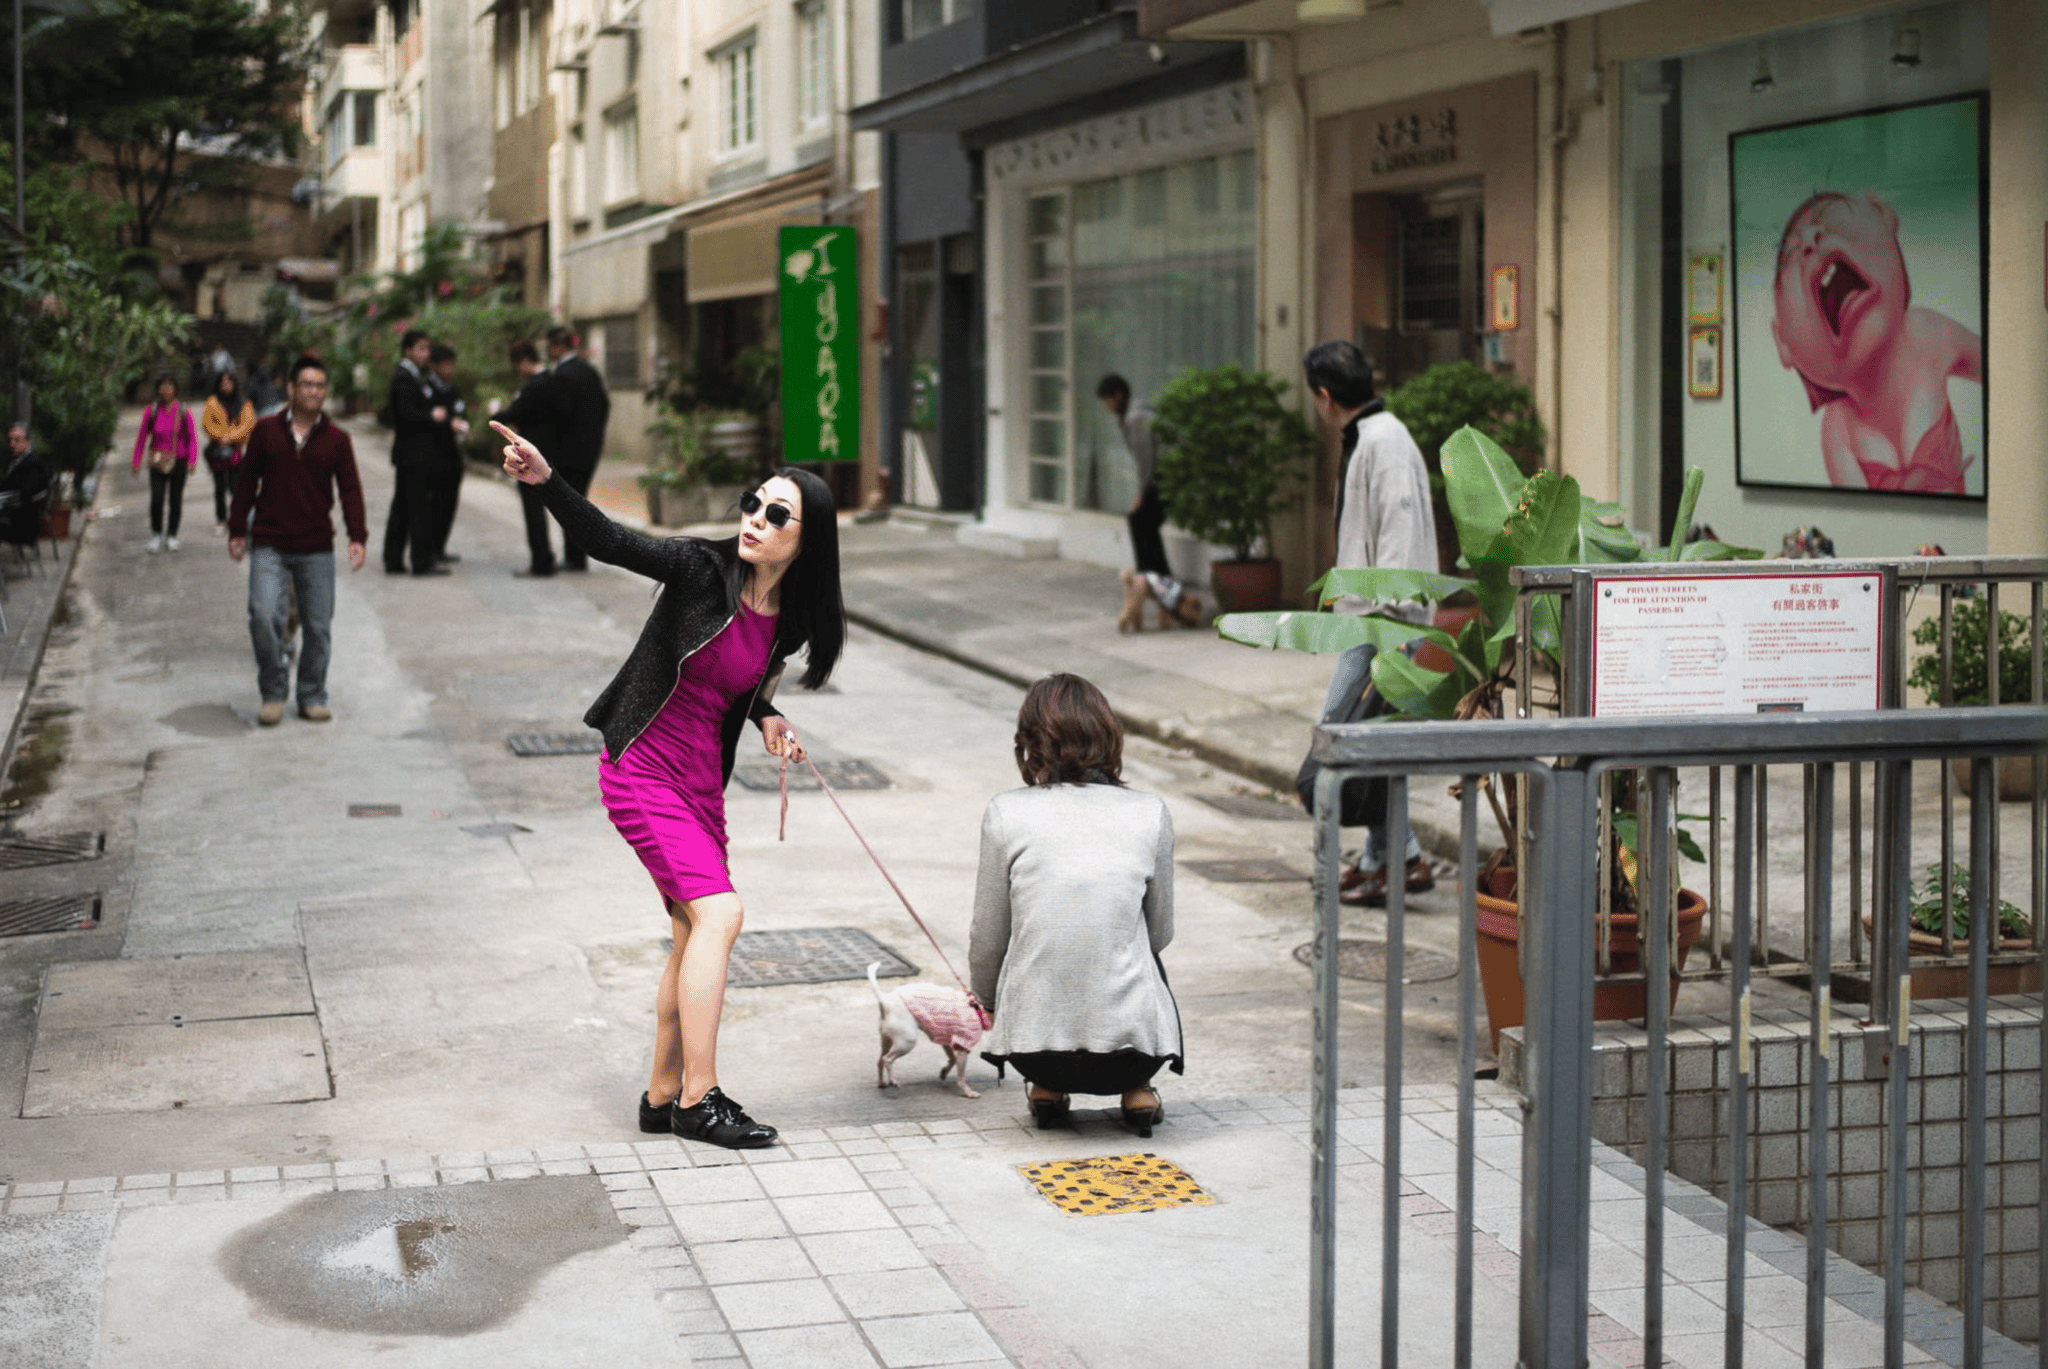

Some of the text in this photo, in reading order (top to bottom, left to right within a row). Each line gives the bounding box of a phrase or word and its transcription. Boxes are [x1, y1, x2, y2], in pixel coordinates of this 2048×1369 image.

[1790, 583, 1823, 595] 私家街
[1613, 597, 1630, 605] FOR
[1650, 596, 1695, 604] ATTENTION
[1696, 595, 1708, 603] OF
[1638, 606, 1684, 614] PASSERS-BY
